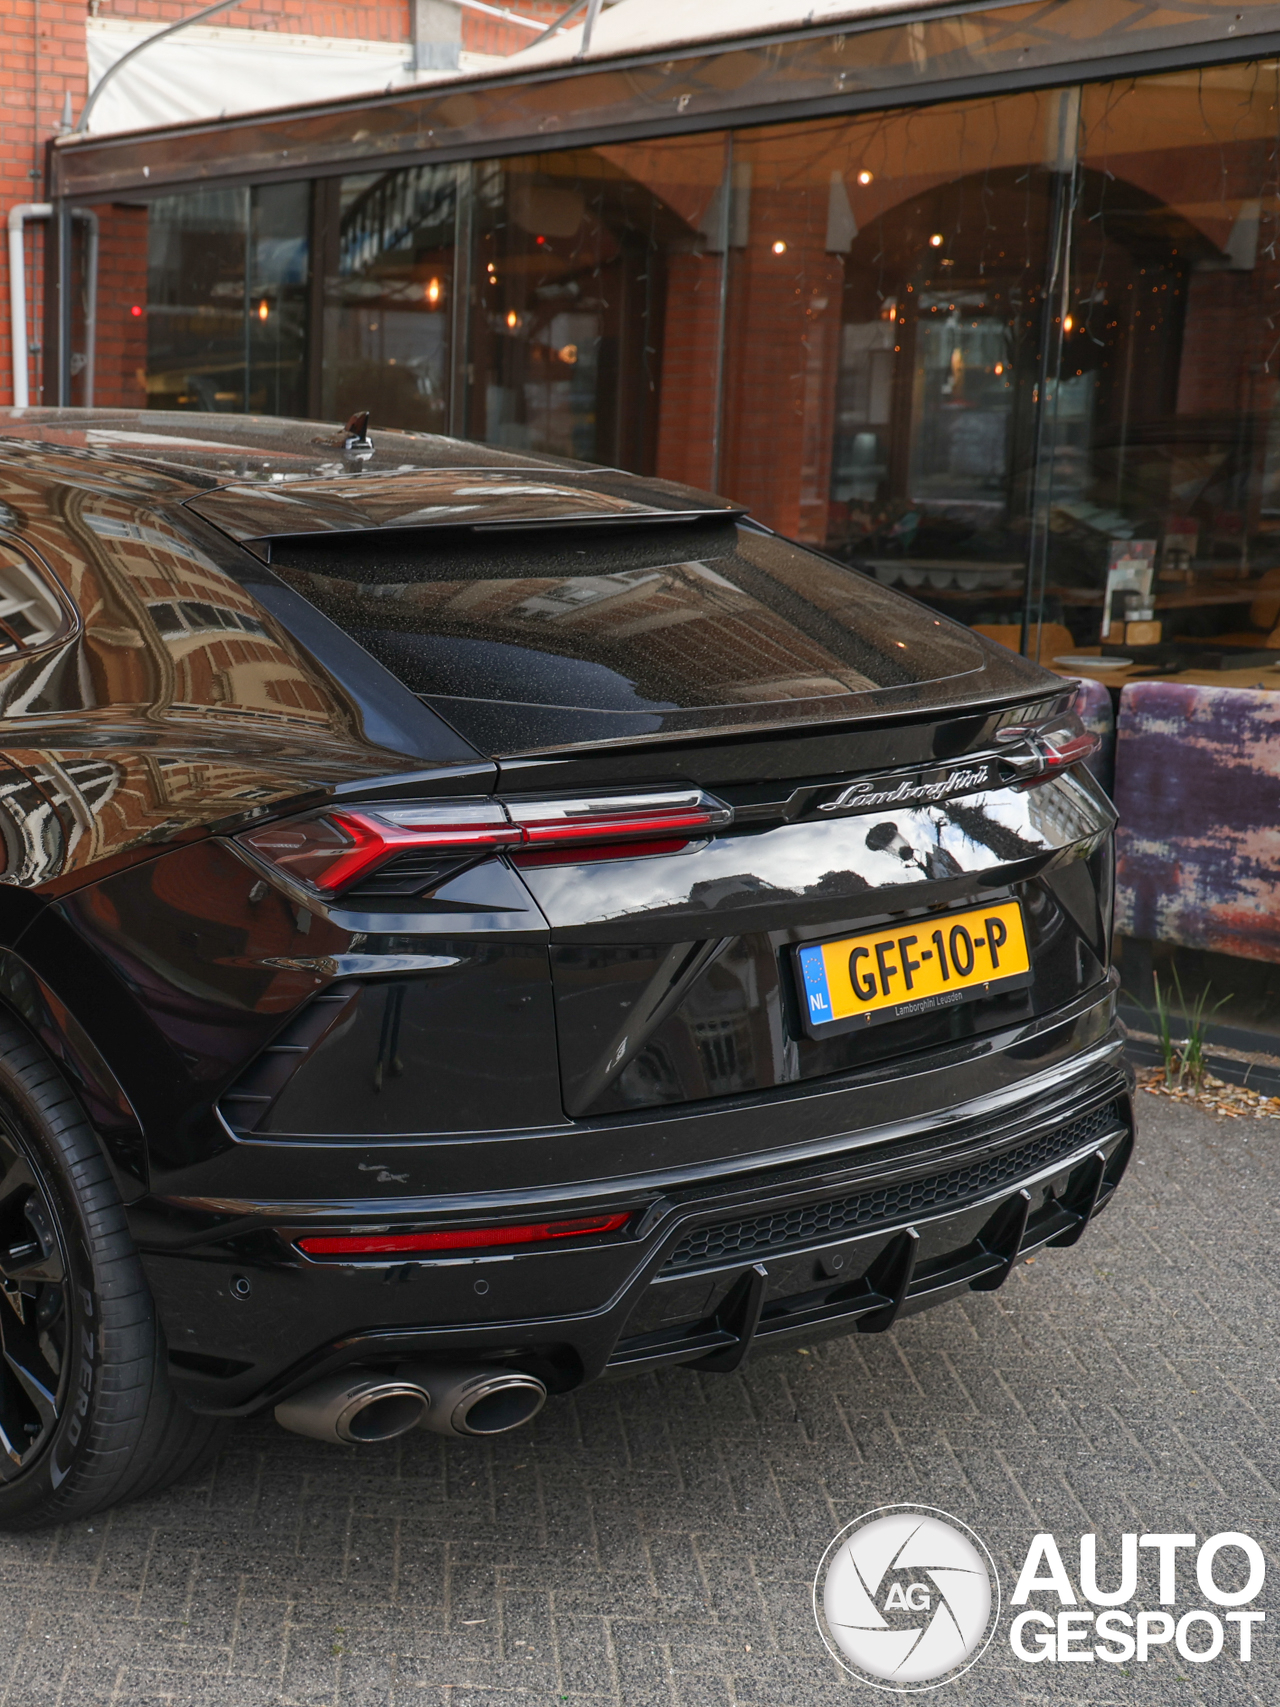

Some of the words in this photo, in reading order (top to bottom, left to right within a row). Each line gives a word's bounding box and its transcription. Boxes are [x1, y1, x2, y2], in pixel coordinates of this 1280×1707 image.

[817, 765, 988, 811] Lamborghini
[848, 917, 1007, 1001] GFF-10-P
[810, 993, 828, 1011] NL
[894, 997, 936, 1017] Lamborghini
[936, 991, 963, 1006] Leusden
[78, 1285, 93, 1317] P
[67, 1325, 94, 1447] ZERO
